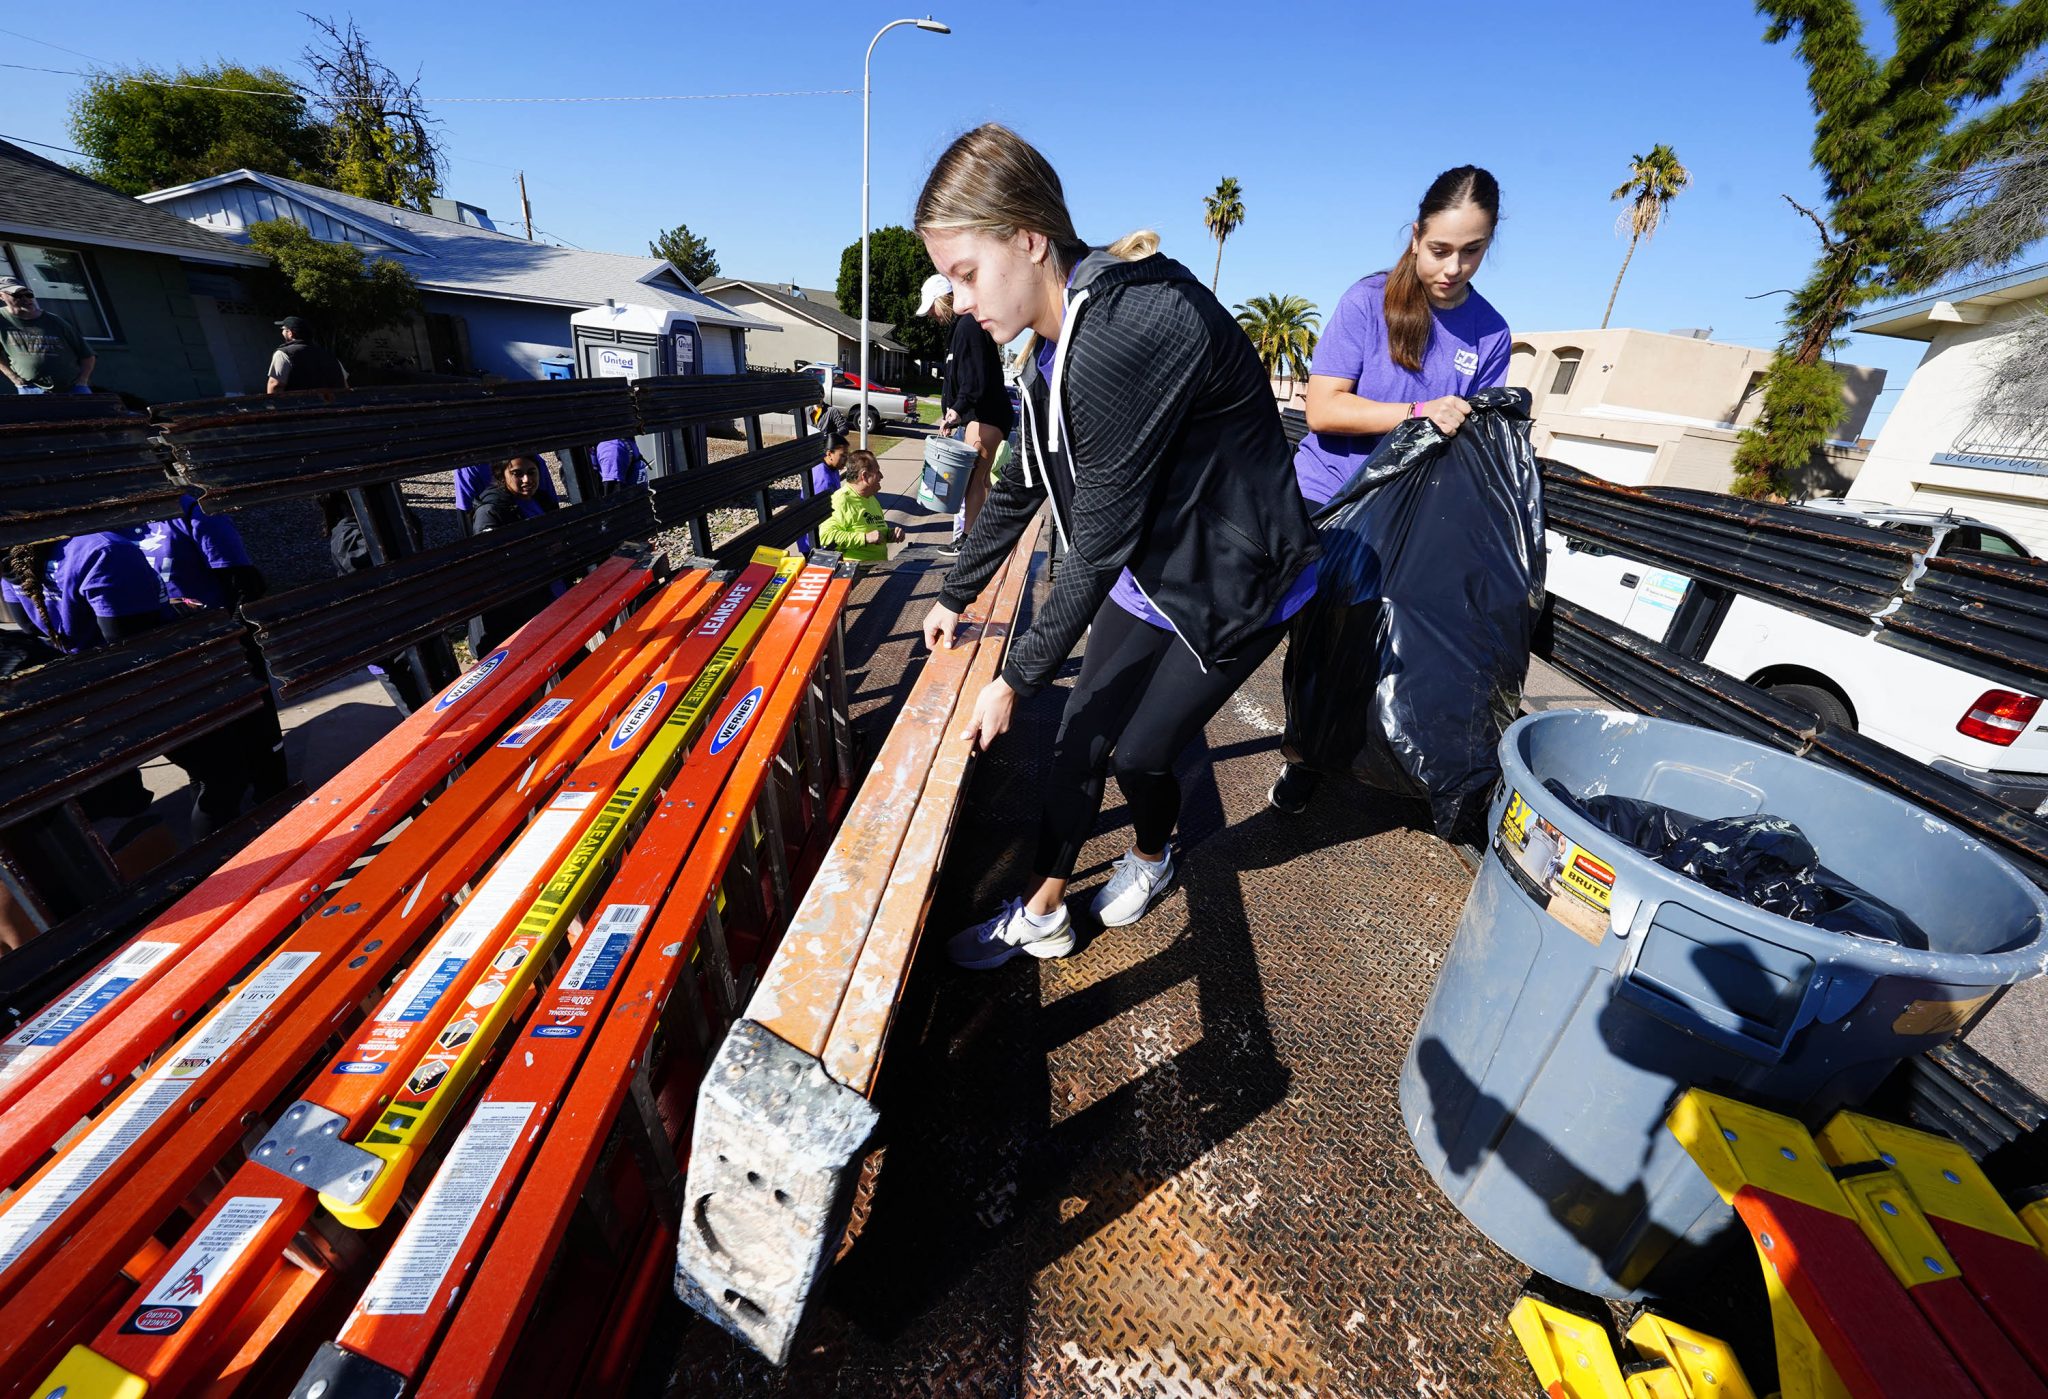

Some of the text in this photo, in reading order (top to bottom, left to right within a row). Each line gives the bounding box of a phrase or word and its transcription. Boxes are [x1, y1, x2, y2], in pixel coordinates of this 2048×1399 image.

[603, 355, 634, 366] United
[788, 572, 830, 602] HfH
[450, 661, 496, 698] WERNER
[687, 659, 724, 702] LEANSAFE
[622, 694, 658, 735] WERNER
[720, 698, 754, 739] WERNER
[1508, 791, 1533, 833] 3X
[551, 822, 612, 892] LEANSAFE
[1568, 871, 1609, 900] BRUTE
[548, 1009, 589, 1017] PROFESSIONAL
[140, 1319, 171, 1327] DANGER
[146, 1311, 178, 1319] PELIGRO
